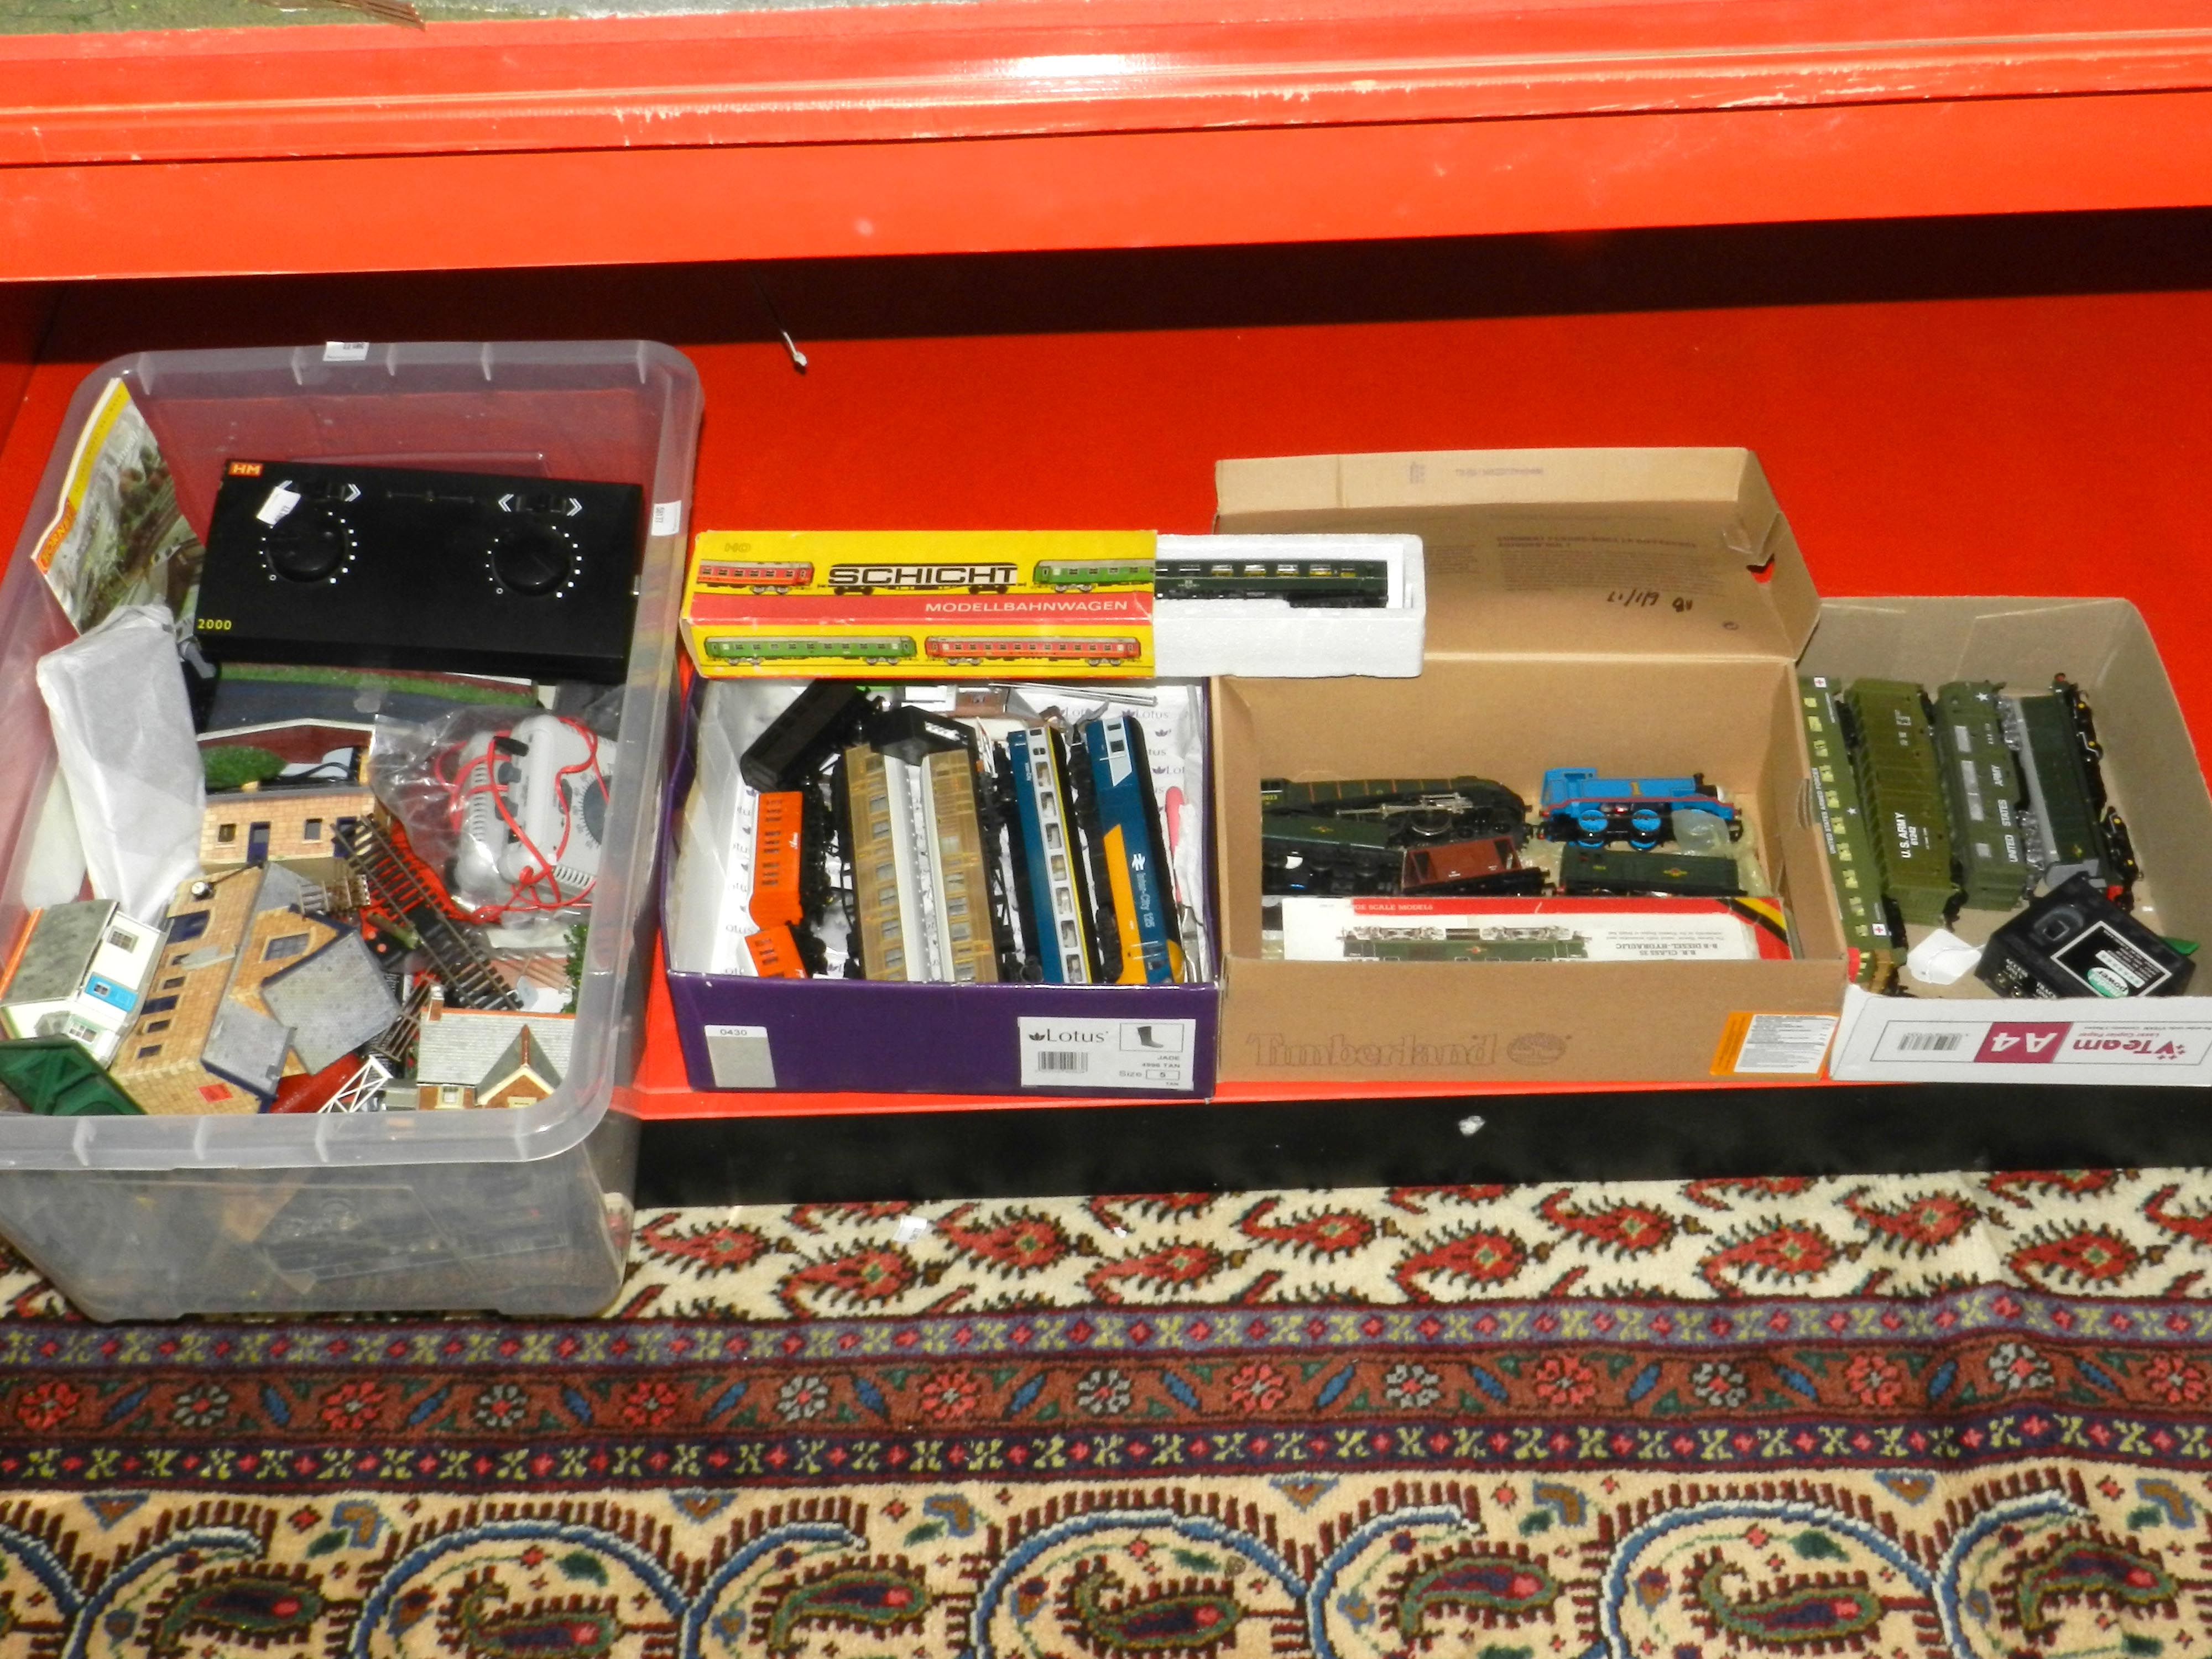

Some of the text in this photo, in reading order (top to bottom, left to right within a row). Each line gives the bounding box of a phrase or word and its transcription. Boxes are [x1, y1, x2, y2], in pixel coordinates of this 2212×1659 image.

[229, 463, 261, 475] HM
[829, 566, 1017, 586] SCHICHT
[925, 600, 1128, 612] MODELLBAHNWAGEN
[197, 619, 232, 630] 2000
[1630, 781, 1643, 797] 1
[1991, 764, 2018, 863] UNITED STATES ARMY
[1894, 811, 1908, 839] ARMY
[1136, 872, 1155, 928] Inter-City 125
[2098, 971, 2127, 993] power
[1047, 1028, 1105, 1043] Lotus
[1991, 1032, 2058, 1052] A4
[1245, 1032, 1498, 1067] Timberland
